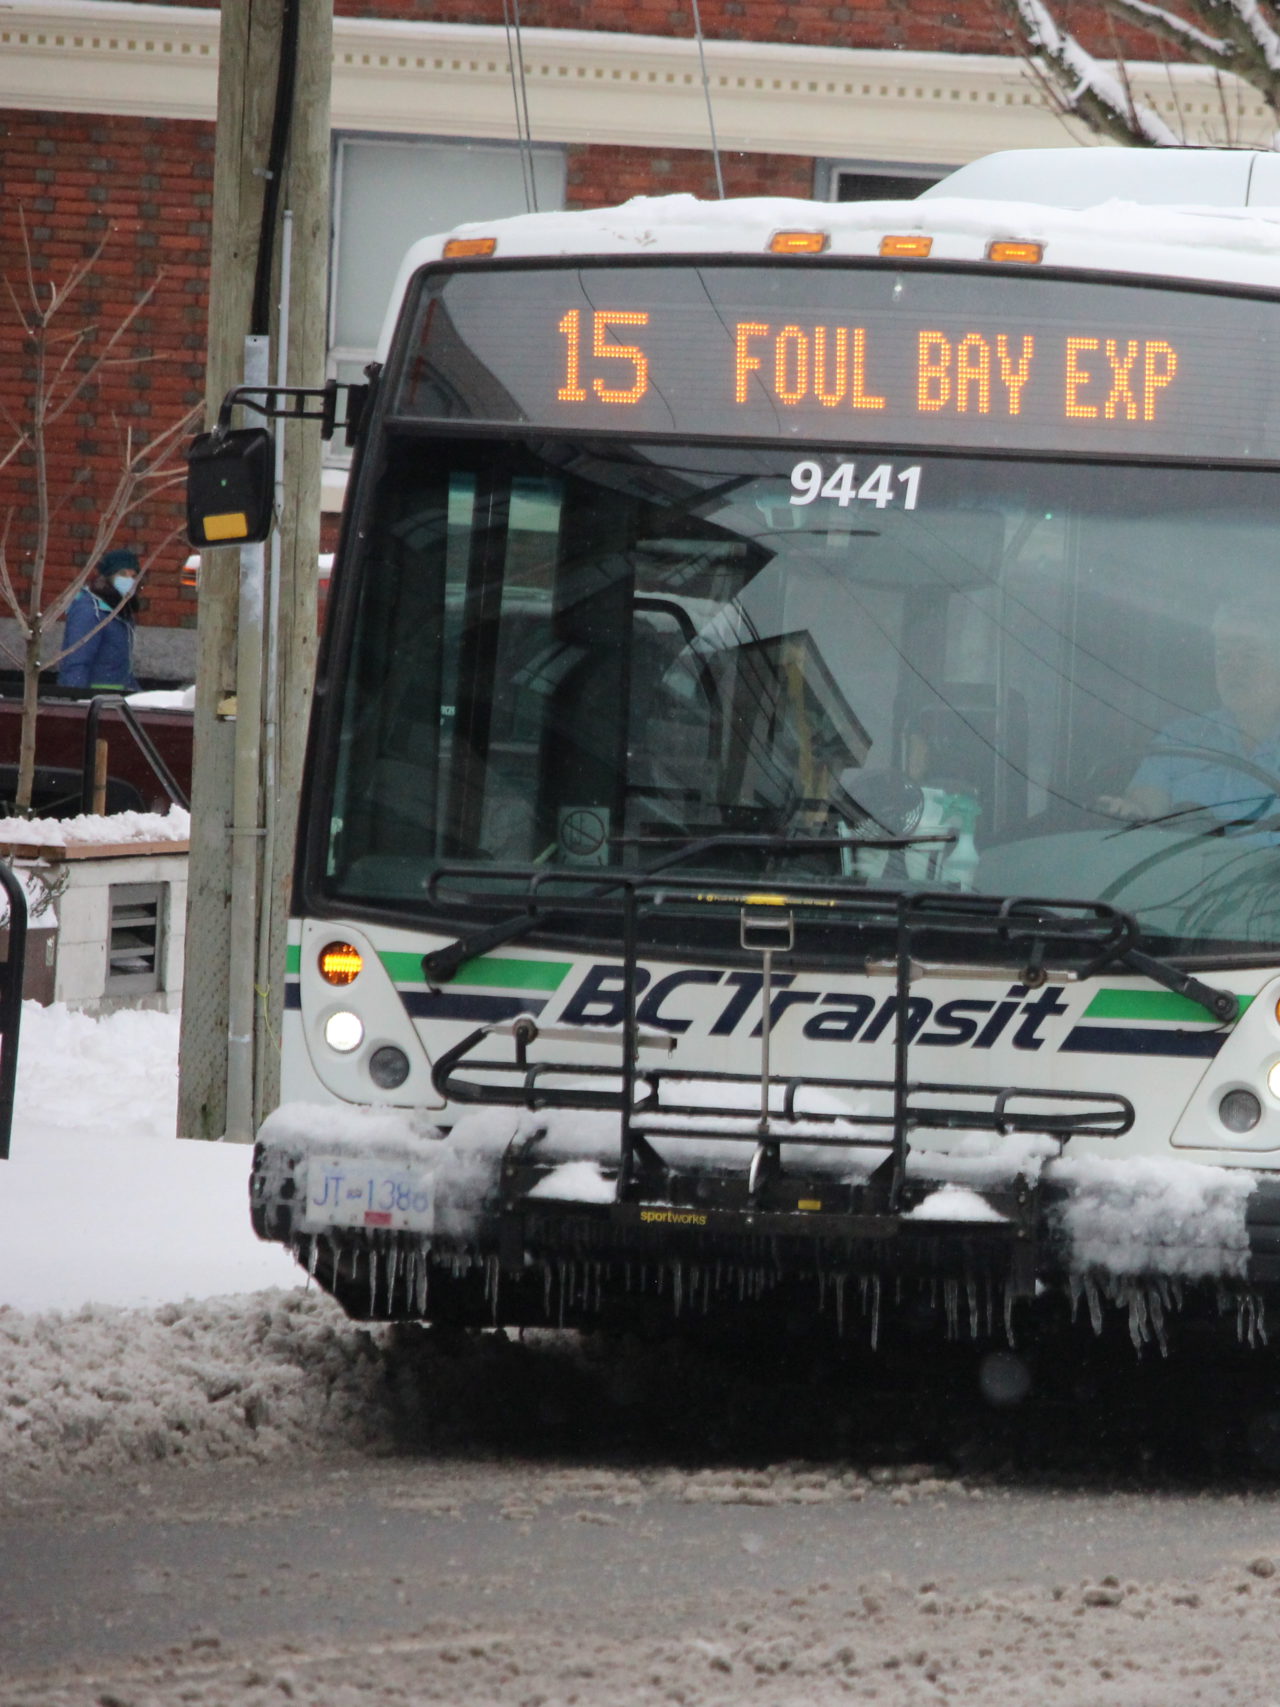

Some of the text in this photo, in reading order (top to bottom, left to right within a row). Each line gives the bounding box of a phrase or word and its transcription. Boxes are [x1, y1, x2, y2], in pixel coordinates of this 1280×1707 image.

[558, 309, 1177, 421] 15 FOUL BAY EXP
[789, 460, 922, 510] 9441
[640, 1209, 707, 1225] sportworks
